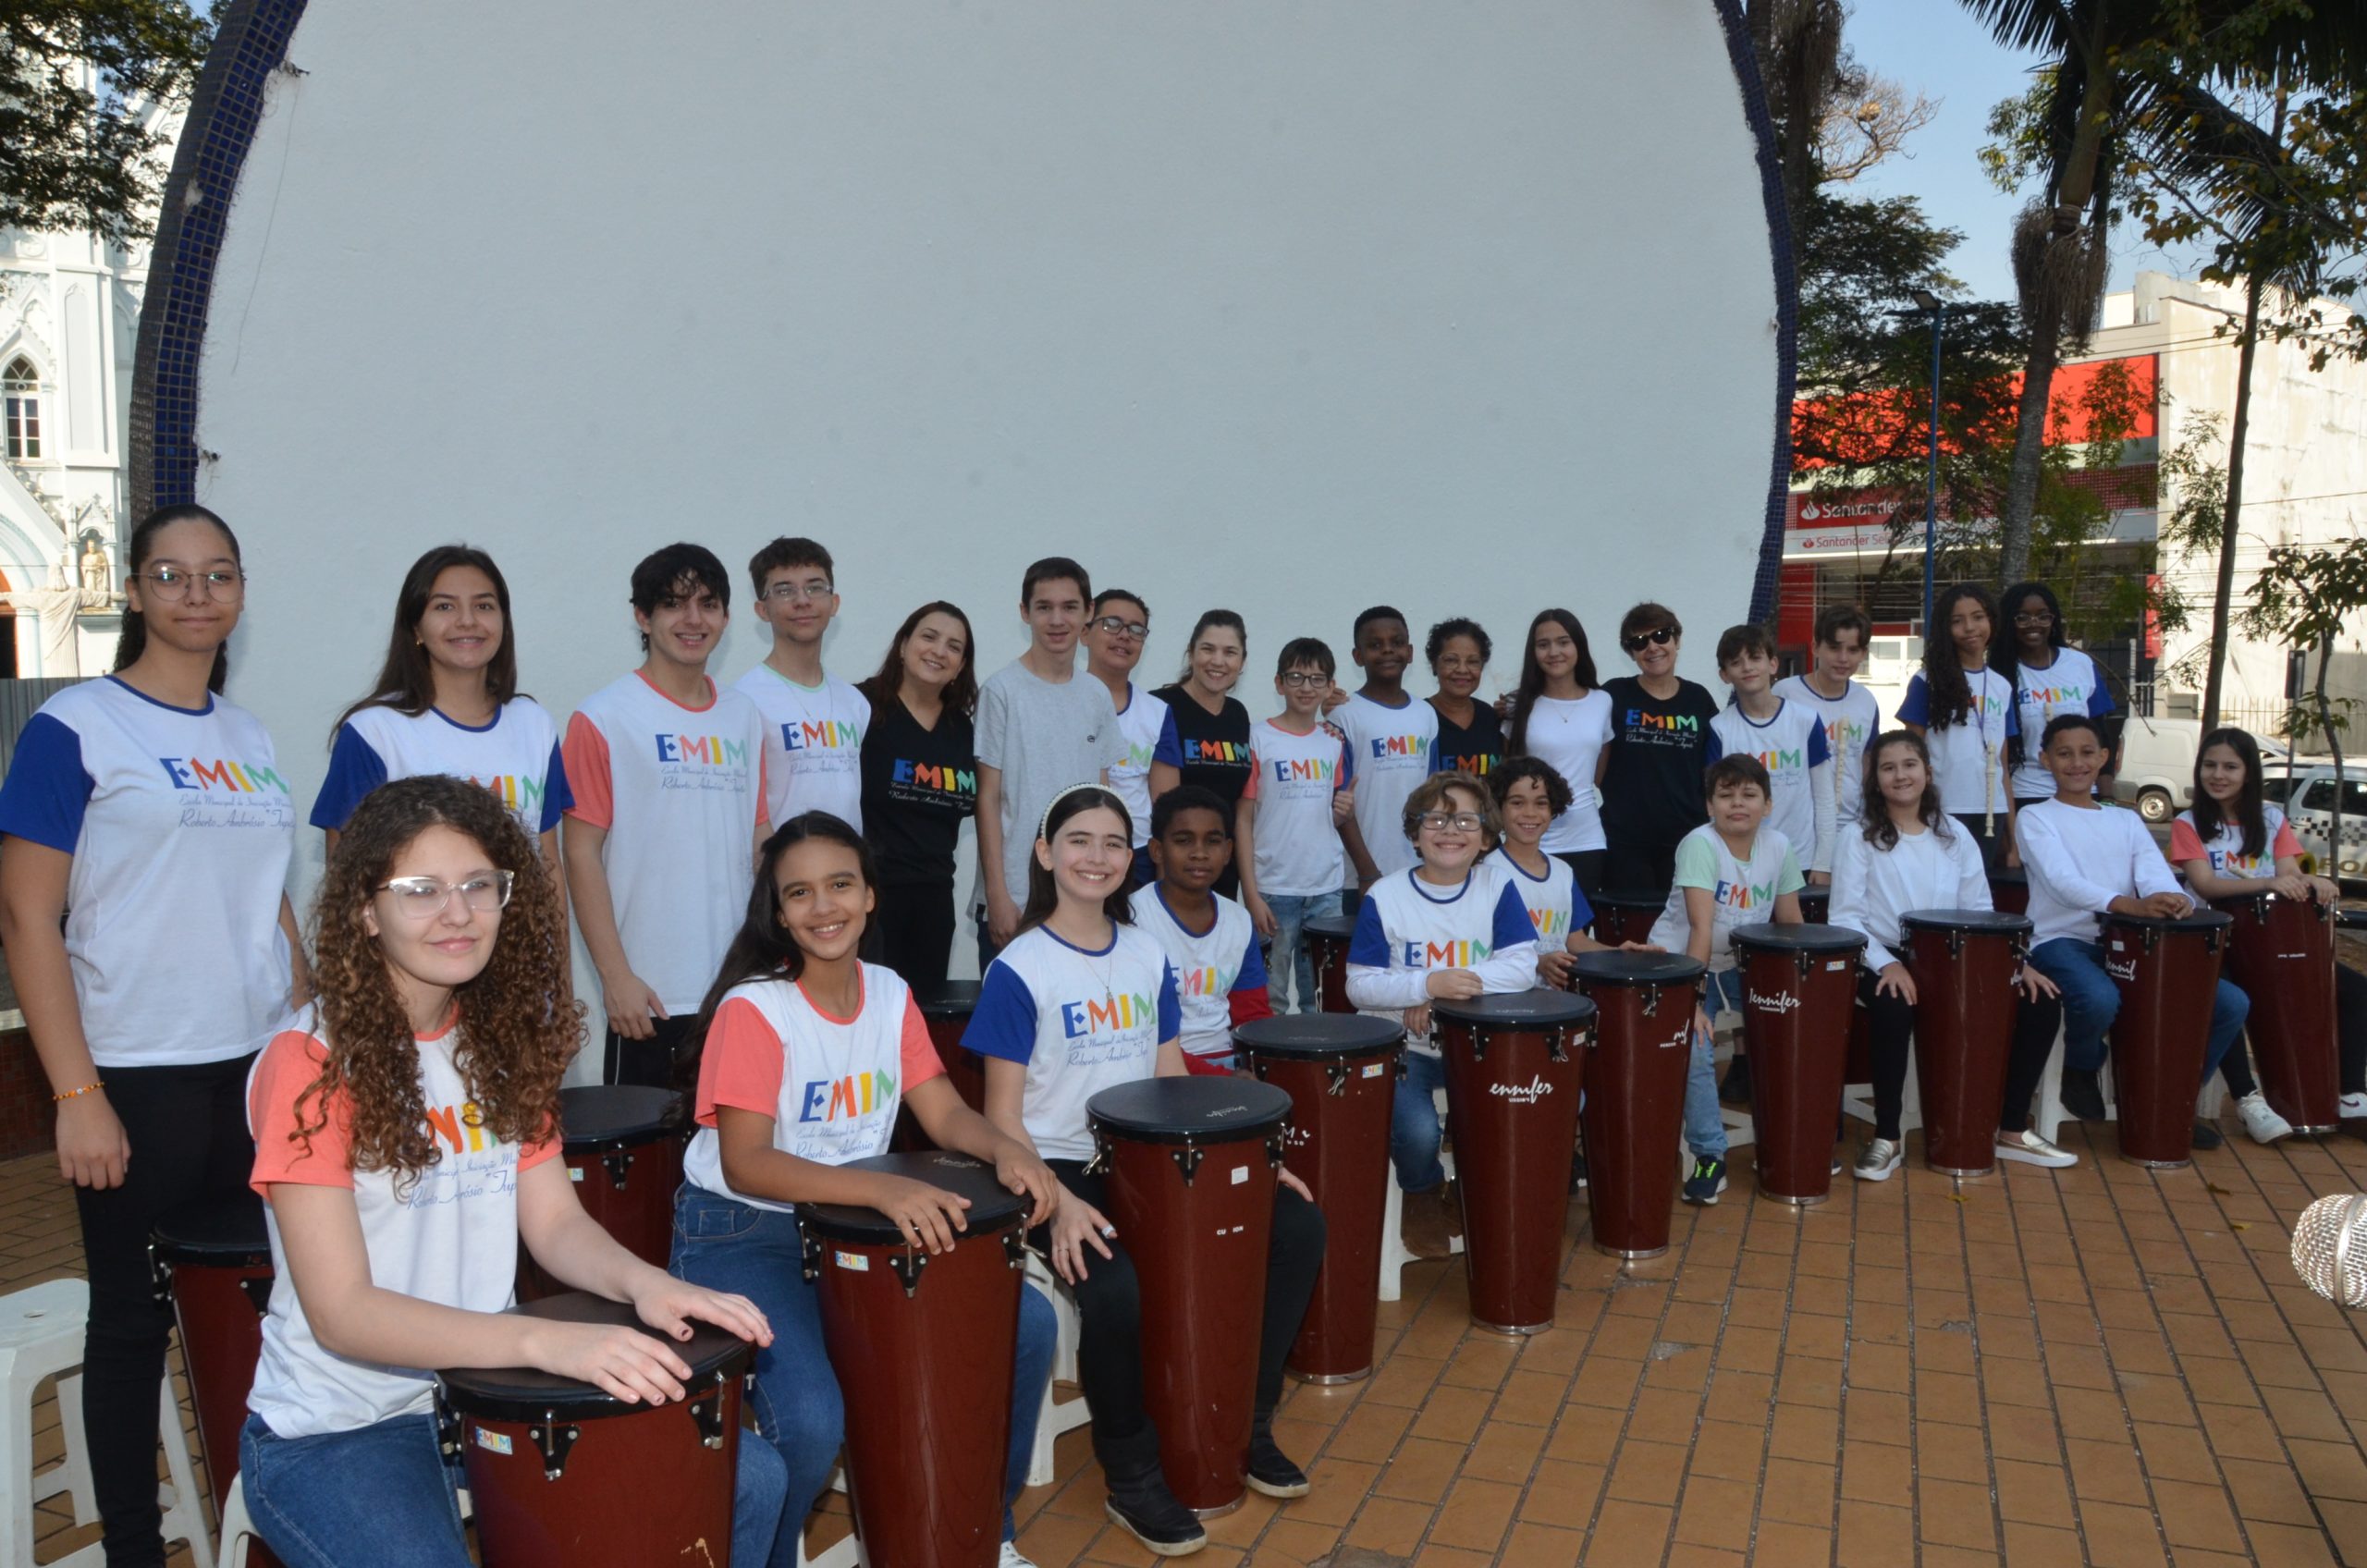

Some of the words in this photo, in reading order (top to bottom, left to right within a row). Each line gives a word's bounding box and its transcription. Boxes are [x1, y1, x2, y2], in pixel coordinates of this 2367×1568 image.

[1817, 535, 1870, 549] Santander
[1626, 709, 1699, 732] EMIM
[781, 720, 859, 751] EMIM
[1371, 734, 1429, 758] EMIM
[655, 733, 748, 768] EMIM
[1184, 739, 1252, 764] EMIM
[159, 757, 288, 794] EMIM
[892, 758, 977, 795] EMIM
[1274, 758, 1334, 782] EMIM
[178, 808, 216, 827] Roberto
[2318, 857, 2367, 875] PO
[1404, 938, 1493, 968] EMIM
[1061, 991, 1157, 1038] EMIM
